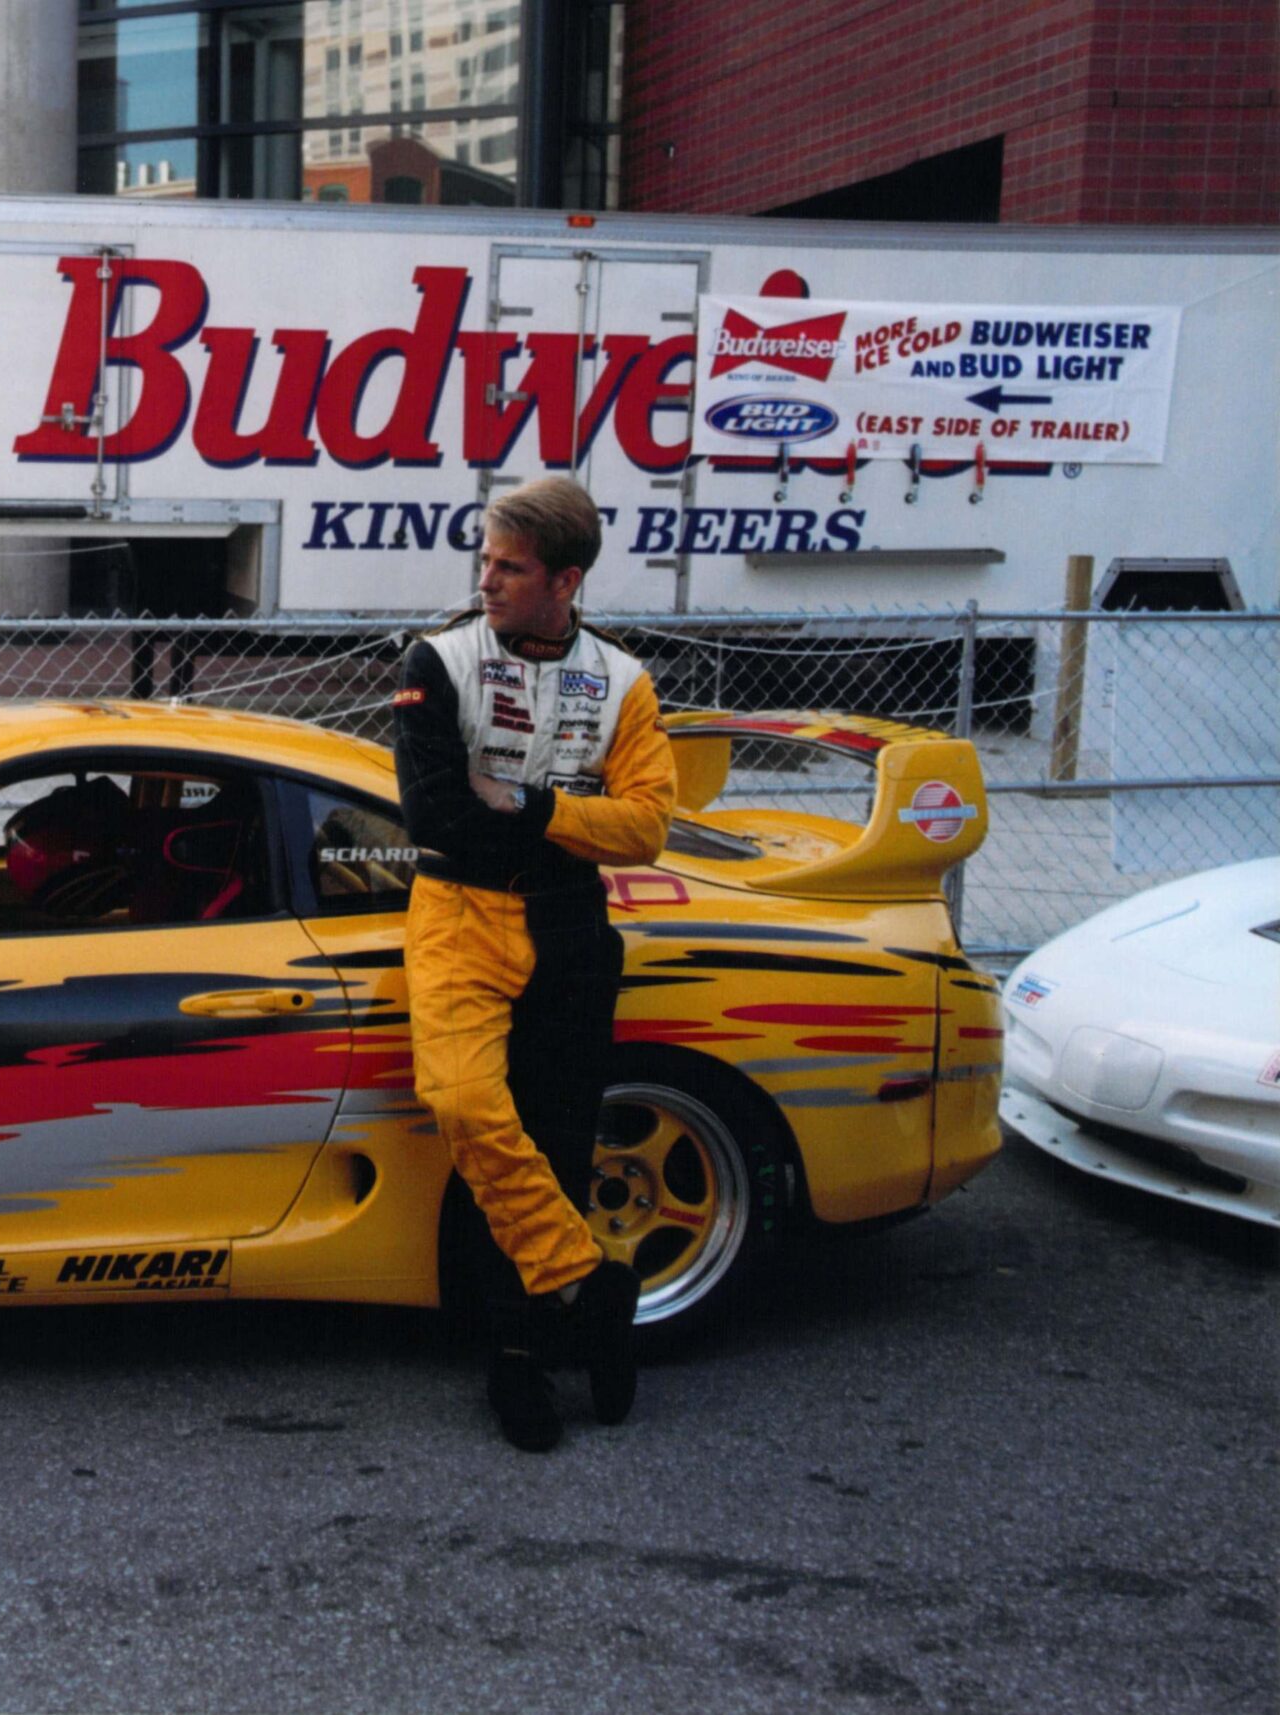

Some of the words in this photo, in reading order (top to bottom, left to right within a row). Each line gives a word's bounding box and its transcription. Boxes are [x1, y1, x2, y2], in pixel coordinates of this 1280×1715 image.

[709, 327, 846, 359] Budweiser
[855, 317, 917, 351] MORE
[855, 346, 889, 374] ICE
[897, 321, 962, 358] COLD
[970, 320, 1152, 350] BUDWEISER
[13, 255, 1051, 476] Budwe
[910, 360, 956, 378] AND
[959, 353, 1022, 379] BUD
[1036, 356, 1124, 381] LIGHT
[723, 418, 821, 431] LIGHT
[739, 404, 810, 417] BUD
[855, 412, 924, 436] (EAST
[933, 417, 982, 436] SIDE
[990, 418, 1020, 438] OF
[1030, 420, 1131, 442] TRAILER)
[628, 507, 866, 554] BEERS
[320, 847, 419, 862] SCHARD
[56, 1249, 229, 1282] HIKARI
